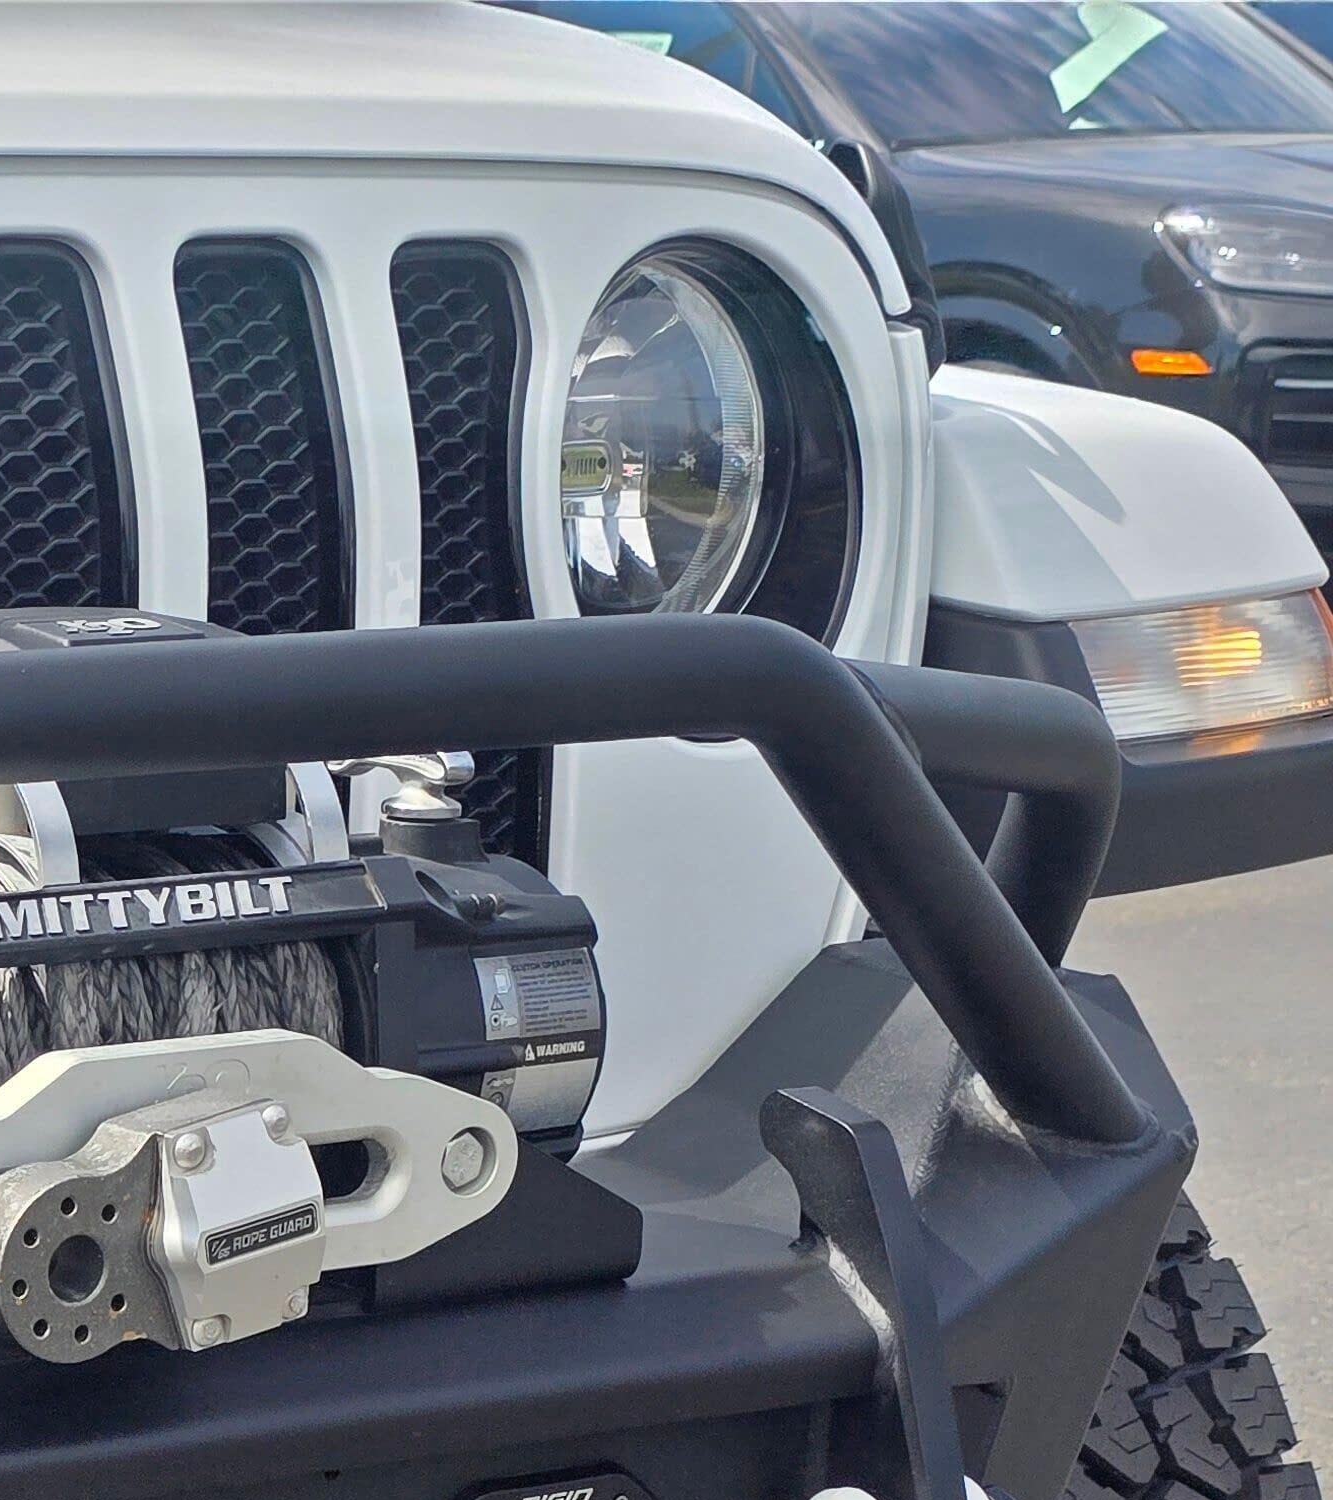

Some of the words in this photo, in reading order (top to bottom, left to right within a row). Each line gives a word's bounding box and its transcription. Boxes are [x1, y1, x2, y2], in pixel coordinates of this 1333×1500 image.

[536, 1040, 585, 1058] WARNING
[233, 1228, 268, 1251] ROPE
[269, 1214, 312, 1240] GUARD
